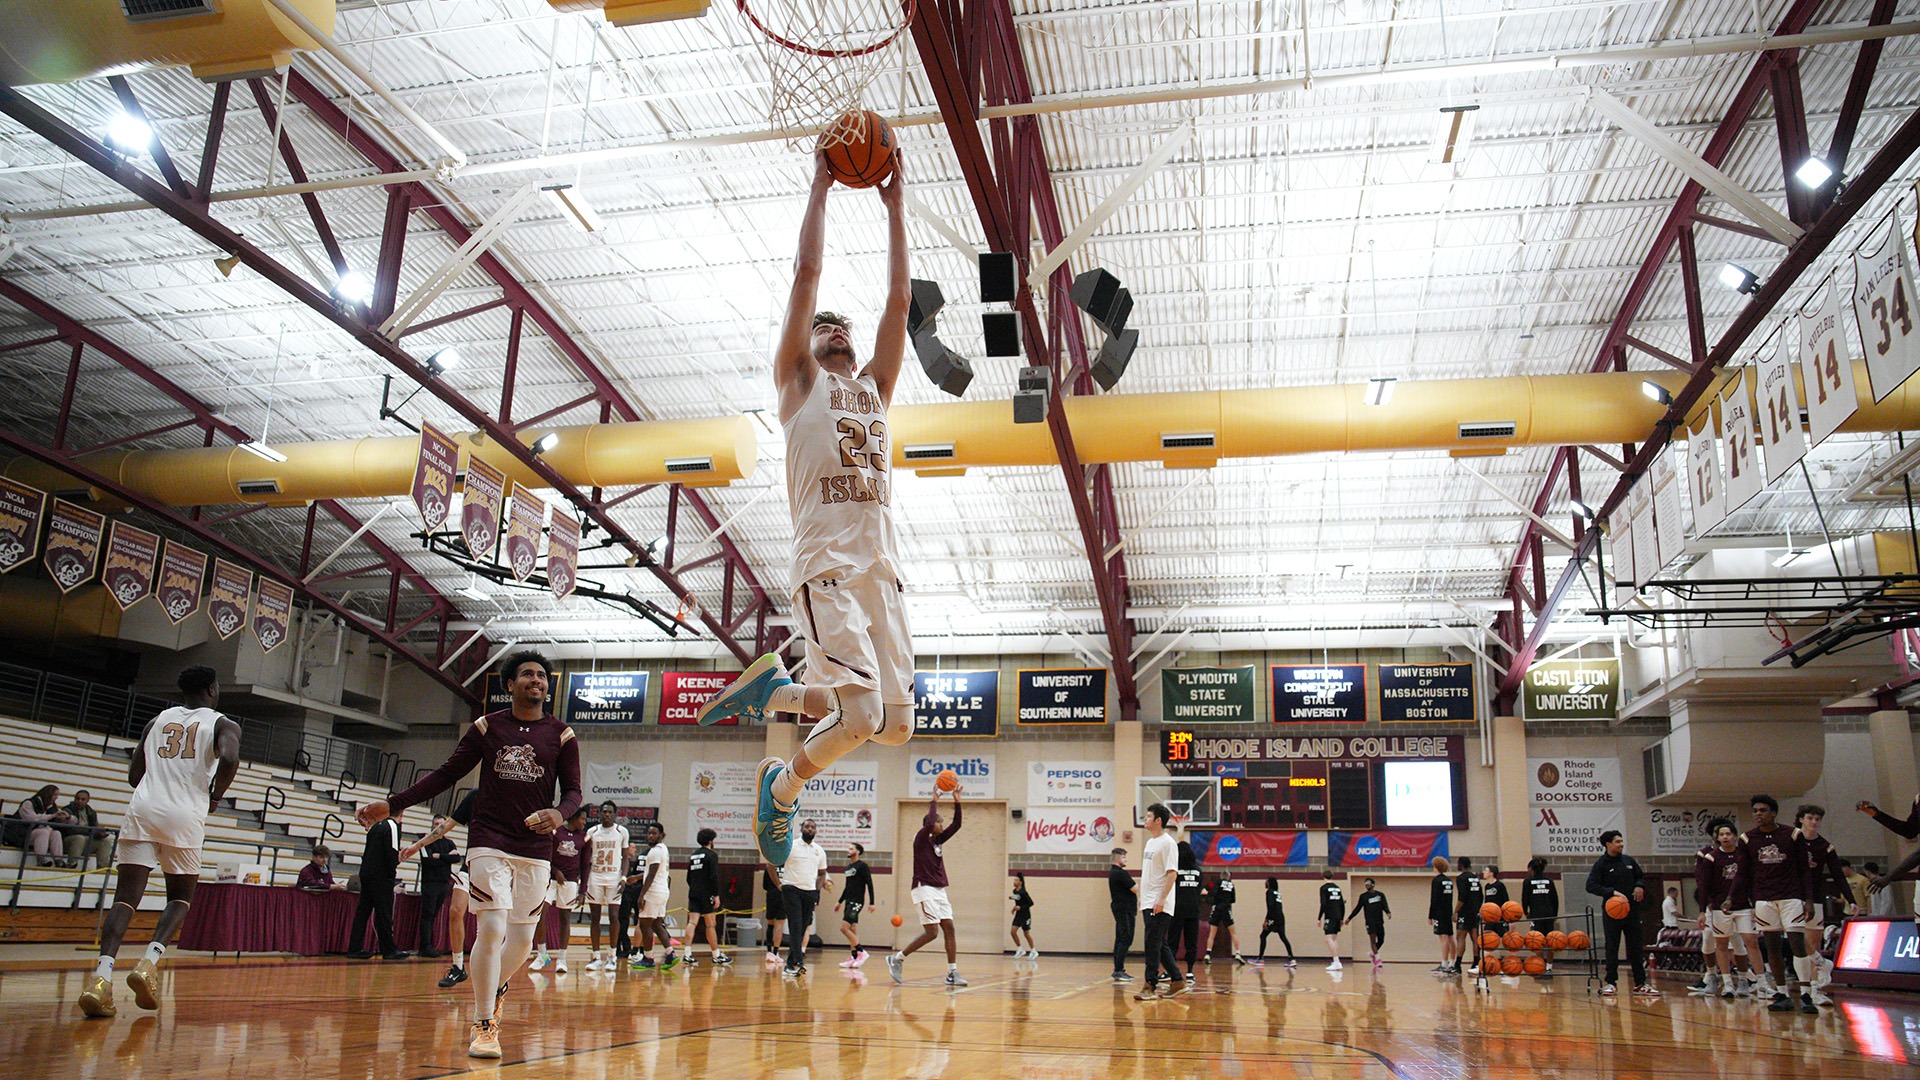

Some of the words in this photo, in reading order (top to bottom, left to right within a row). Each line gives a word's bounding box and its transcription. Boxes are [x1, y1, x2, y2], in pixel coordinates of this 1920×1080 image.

[1871, 276, 1913, 357] 34
[1814, 338, 1842, 406] 14
[1768, 383, 1793, 446] 14
[432, 441, 447, 458] NCAA
[836, 417, 889, 473] 23
[1729, 425, 1749, 480] 14
[423, 448, 439, 466] FINAL
[438, 459, 453, 475] FOUR
[423, 464, 448, 497] 2023
[1696, 457, 1714, 507] 12
[820, 474, 892, 508] ISLA
[5, 491, 26, 505] NCAA
[0, 500, 12, 511] ITE
[13, 505, 38, 520] EIGHT
[0, 511, 28, 538] 007
[51, 520, 99, 543] CHAMPIONS
[164, 571, 197, 597] 2004
[1293, 669, 1344, 680] WESTERN
[1394, 667, 1457, 677] UNIVERSITY
[1533, 669, 1609, 687] CASTLETON
[584, 676, 633, 687] EASTERN
[677, 677, 727, 689] KEENE
[924, 677, 968, 692] THE
[1032, 675, 1093, 688] UNIVERSITY
[1178, 673, 1238, 685] PLYMOUTH
[1054, 691, 1069, 703] OF
[1190, 689, 1226, 701] STATE
[1384, 687, 1469, 698] MASSACHUSETTS
[590, 700, 622, 709] STATE
[1303, 694, 1336, 705] STATE
[1536, 693, 1609, 711] UNIVERSITY
[575, 711, 634, 721] UNIVERSITY
[1020, 707, 1071, 720] SOUTHERN
[1073, 706, 1104, 719] MAINE
[1175, 705, 1242, 717] UNIVERSITY
[1291, 708, 1348, 719] UNIVERSITY
[1406, 708, 1448, 718] BOSTON
[916, 716, 972, 729] EAST
[157, 721, 200, 760] 31
[1169, 732, 1193, 743] 3:04
[1168, 743, 1189, 760] 30
[1194, 738, 1261, 759] RHODE
[1265, 738, 1345, 759] ISLAND
[1350, 737, 1449, 758] COLLEGE
[915, 758, 990, 776] Cardi's
[1564, 760, 1596, 769] Rhode
[1047, 769, 1102, 779] PEPSICO
[1565, 770, 1594, 779] Island
[1222, 778, 1239, 787] RIC
[1289, 778, 1327, 787] NICHOLS
[1565, 780, 1603, 790] College
[1047, 796, 1102, 804] Foodservice
[1535, 793, 1613, 802] BOOKSTORE
[707, 811, 753, 820] SingleSour
[1651, 809, 1681, 823] Brew
[1026, 816, 1087, 842] Wendy's
[1549, 827, 1602, 836] MARRIOTT
[1658, 826, 1695, 837] Coffee
[1549, 836, 1601, 844] PROVIDEN
[1218, 847, 1242, 856] NCAA
[1243, 847, 1271, 855] Division
[1357, 847, 1381, 856] NCAA
[1382, 847, 1410, 855] Division
[1550, 845, 1605, 853] DOWNTOW
[595, 850, 614, 866] 24
